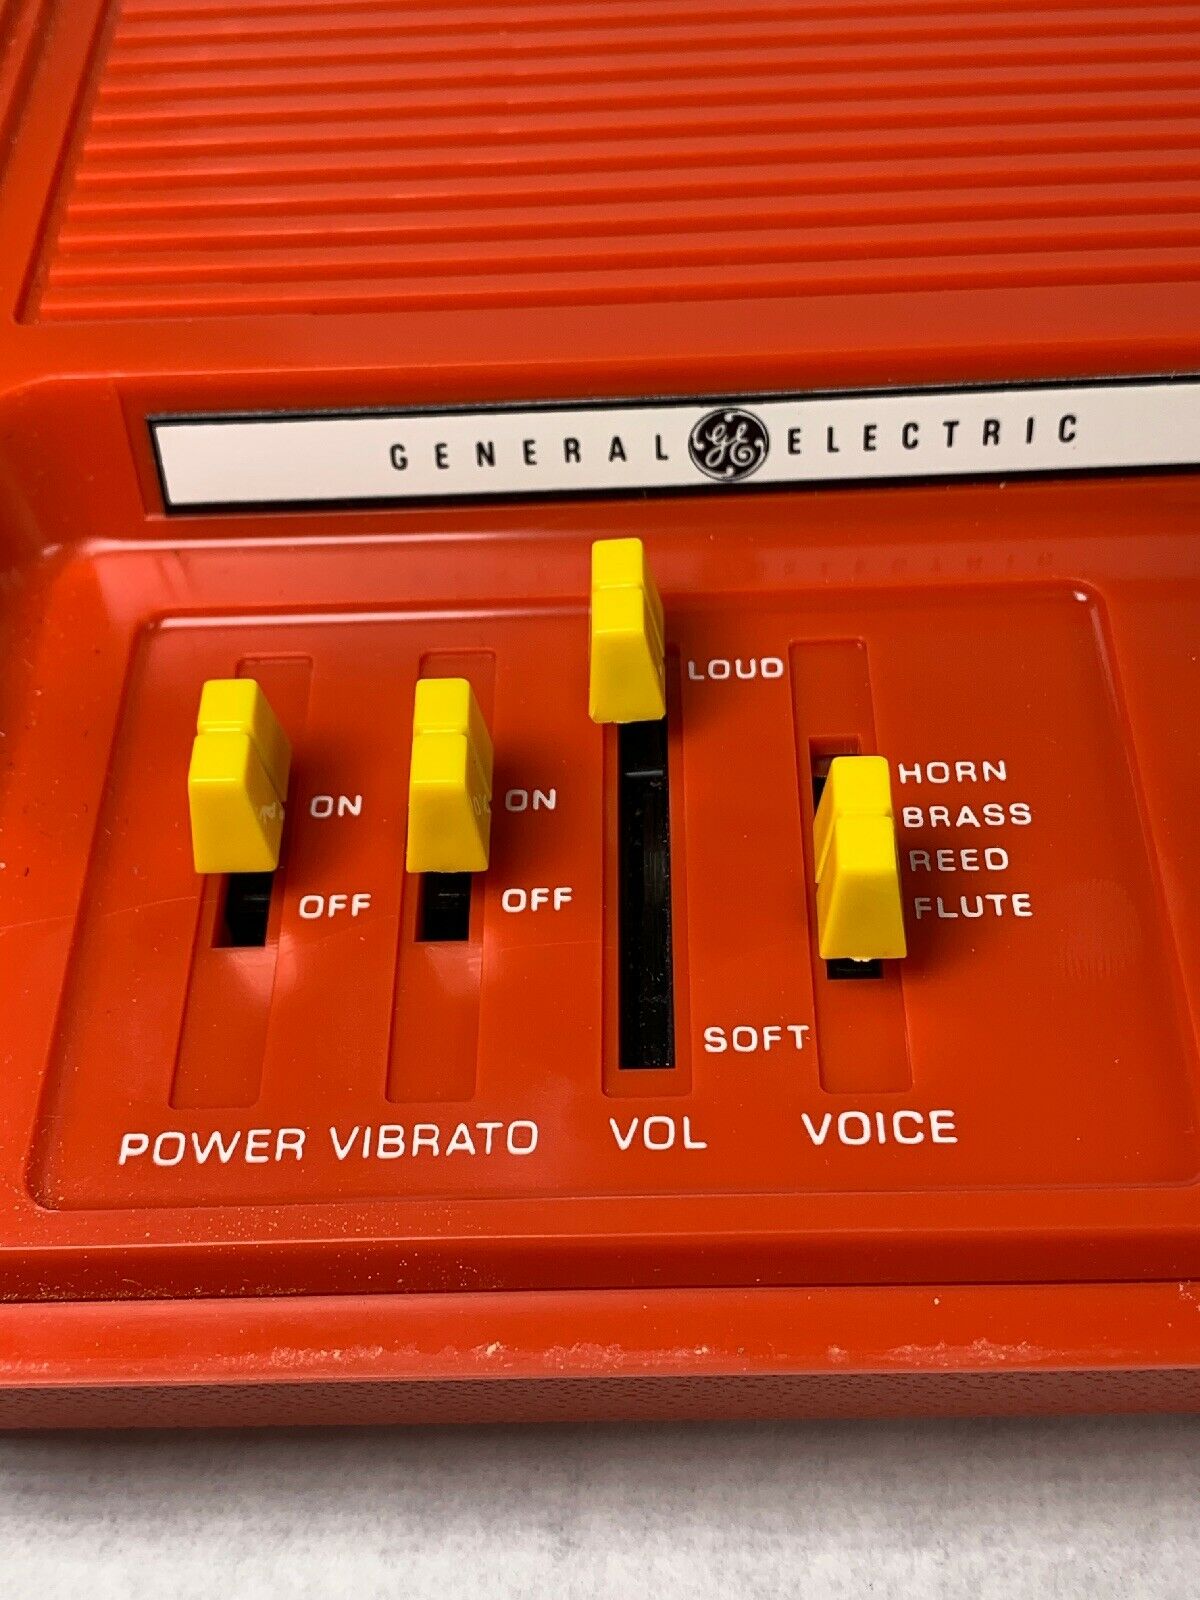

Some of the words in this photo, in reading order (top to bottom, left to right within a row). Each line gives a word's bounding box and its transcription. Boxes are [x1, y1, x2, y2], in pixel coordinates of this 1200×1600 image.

[389, 434, 670, 472] GENERAL
[787, 414, 1078, 455] ELECTRIC
[687, 657, 784, 680] LOUD
[898, 760, 1008, 784] HORN
[310, 794, 363, 818] ON
[505, 788, 557, 812] ON
[902, 802, 1033, 828] BRASS
[909, 847, 1009, 872] REED
[298, 893, 372, 919] OFF
[501, 887, 573, 913] OFF
[914, 893, 1033, 919] FLUTE
[703, 1024, 810, 1053] SOFT
[329, 1120, 539, 1161] VIBRATO
[608, 1115, 707, 1150] VOL
[801, 1109, 958, 1146] VOICE
[118, 1127, 306, 1166] POWER
